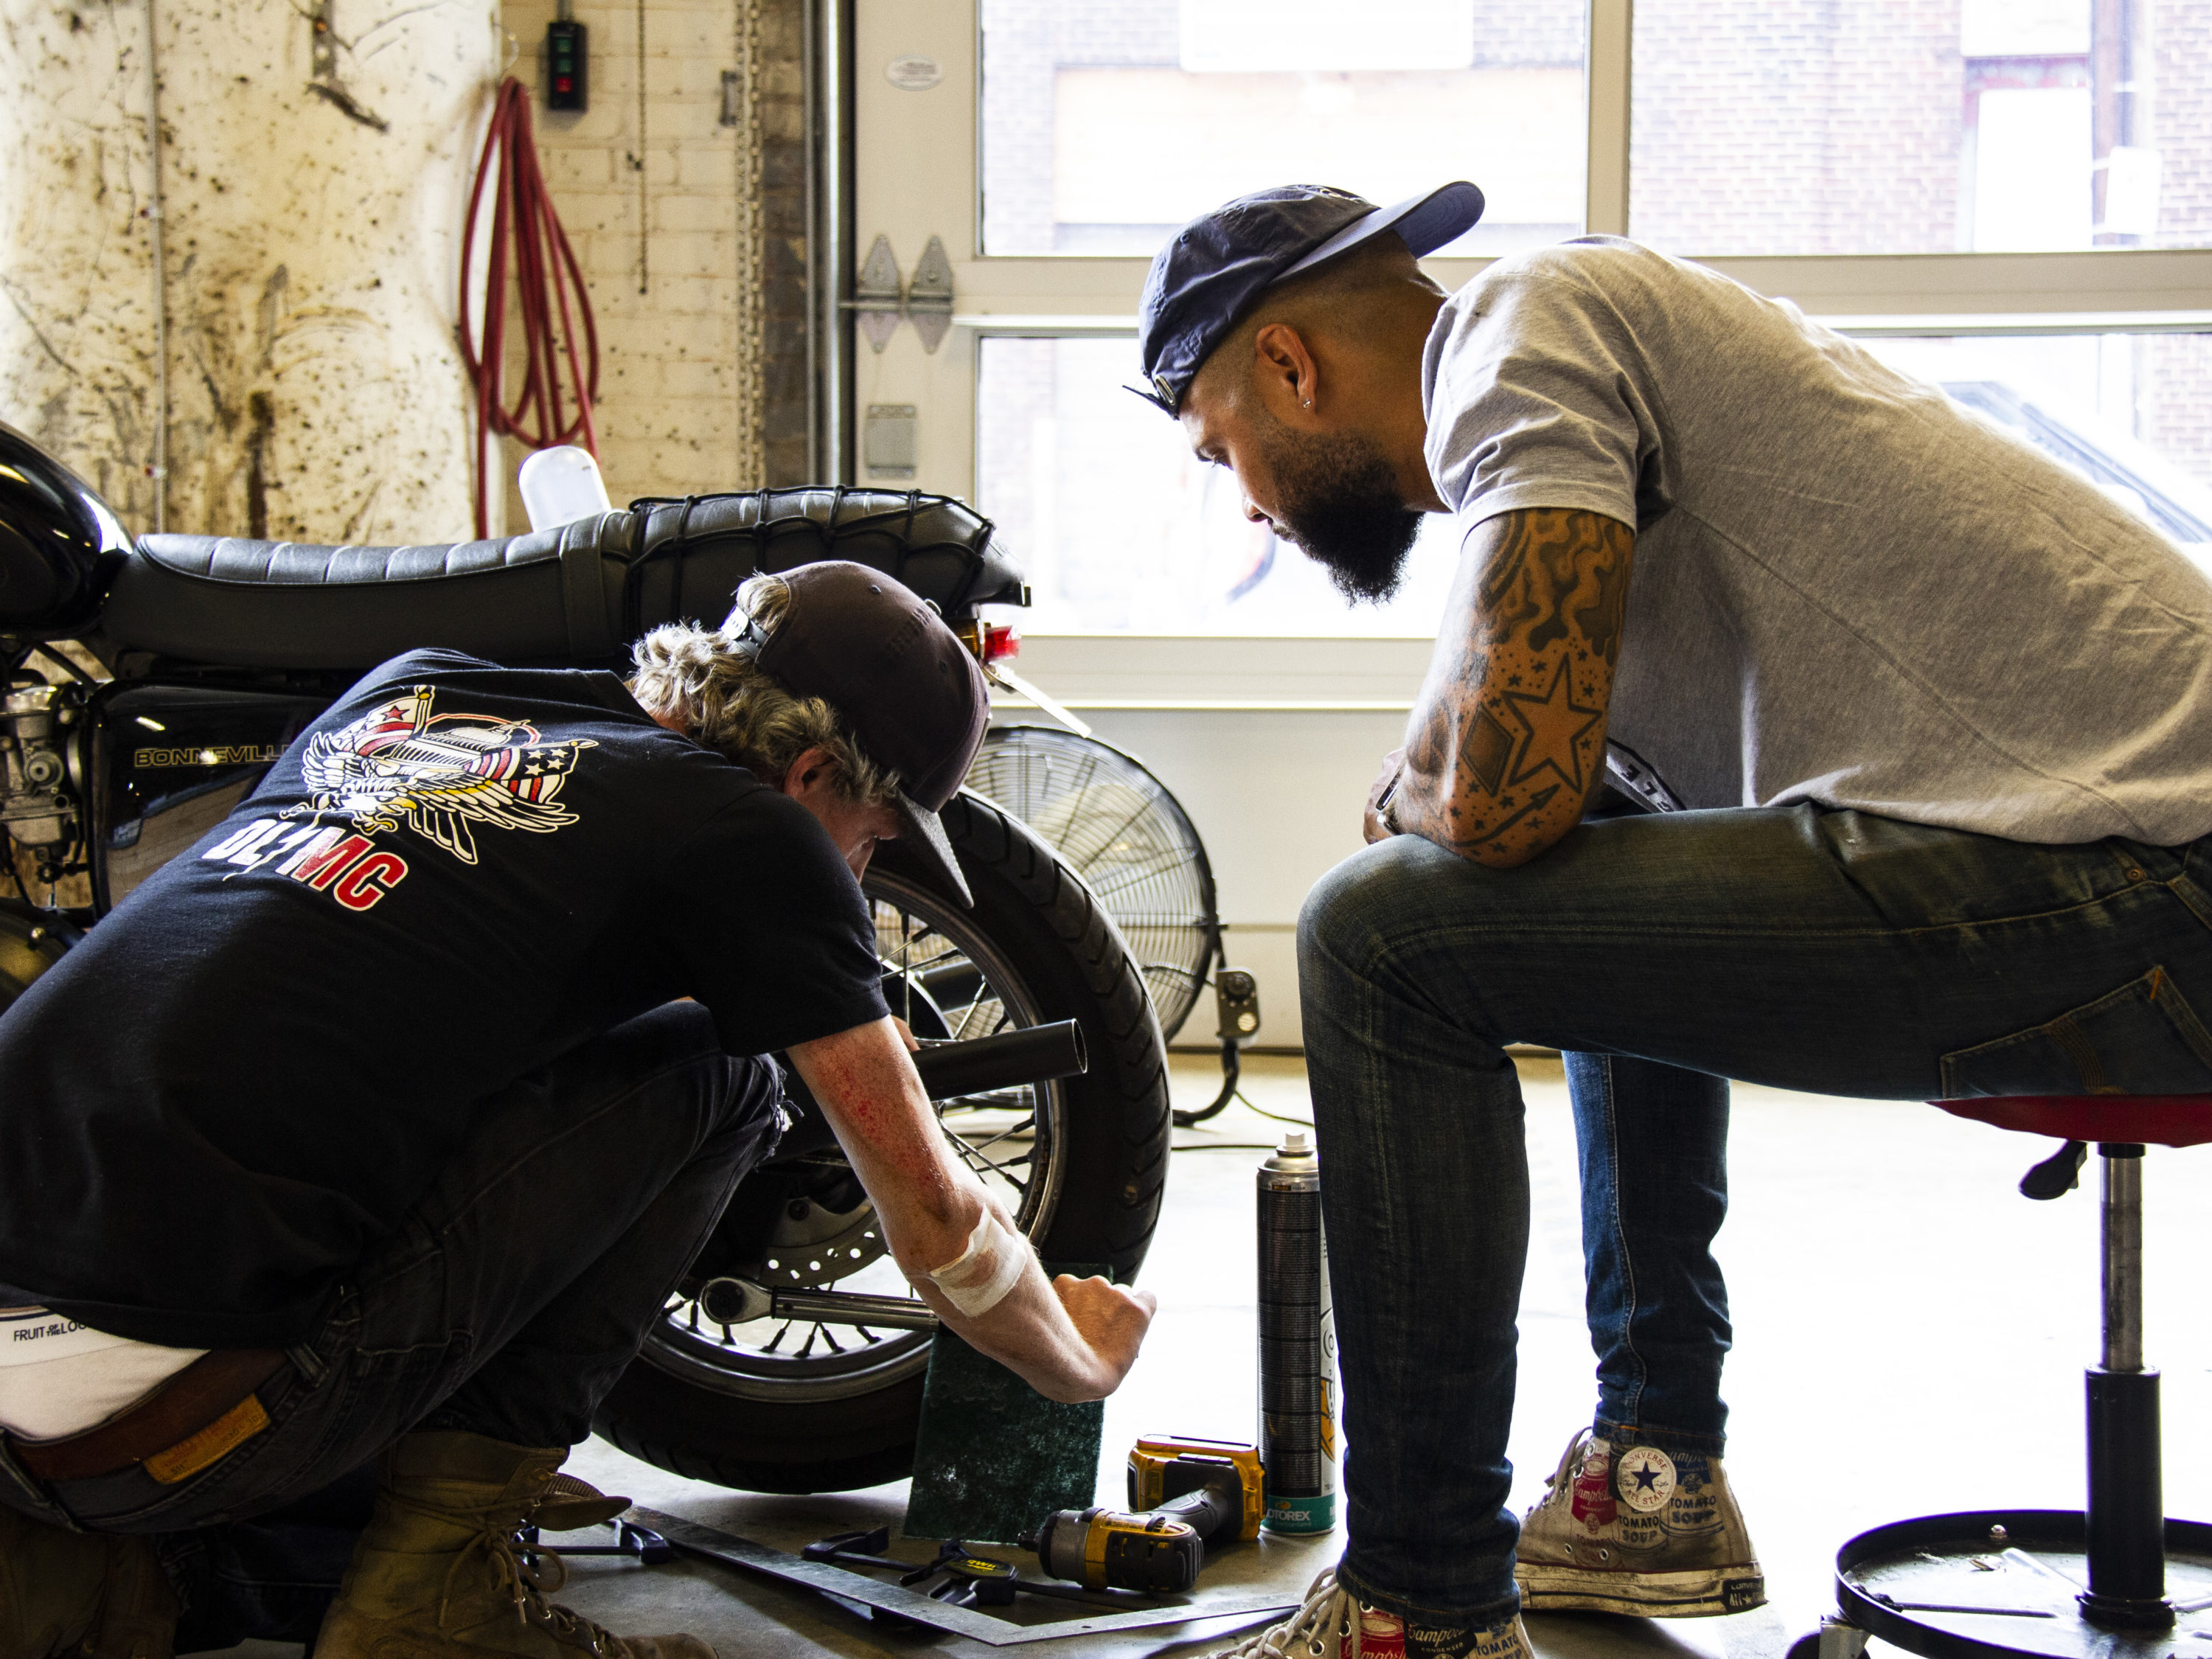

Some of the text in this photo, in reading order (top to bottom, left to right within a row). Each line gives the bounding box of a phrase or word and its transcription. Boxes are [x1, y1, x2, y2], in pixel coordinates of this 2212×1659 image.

[13, 1326, 45, 1342] FRUIT
[46, 1329, 60, 1337] THE
[49, 1324, 59, 1332] OF
[1625, 1452, 1668, 1470] CONVERSE
[1625, 1489, 1665, 1506] ALL STAR
[1670, 1495, 1717, 1509] TOMATO
[1618, 1514, 1659, 1528] TOMATO
[1623, 1528, 1658, 1543] SOUP
[1421, 1642, 1464, 1652] CONDENSED
